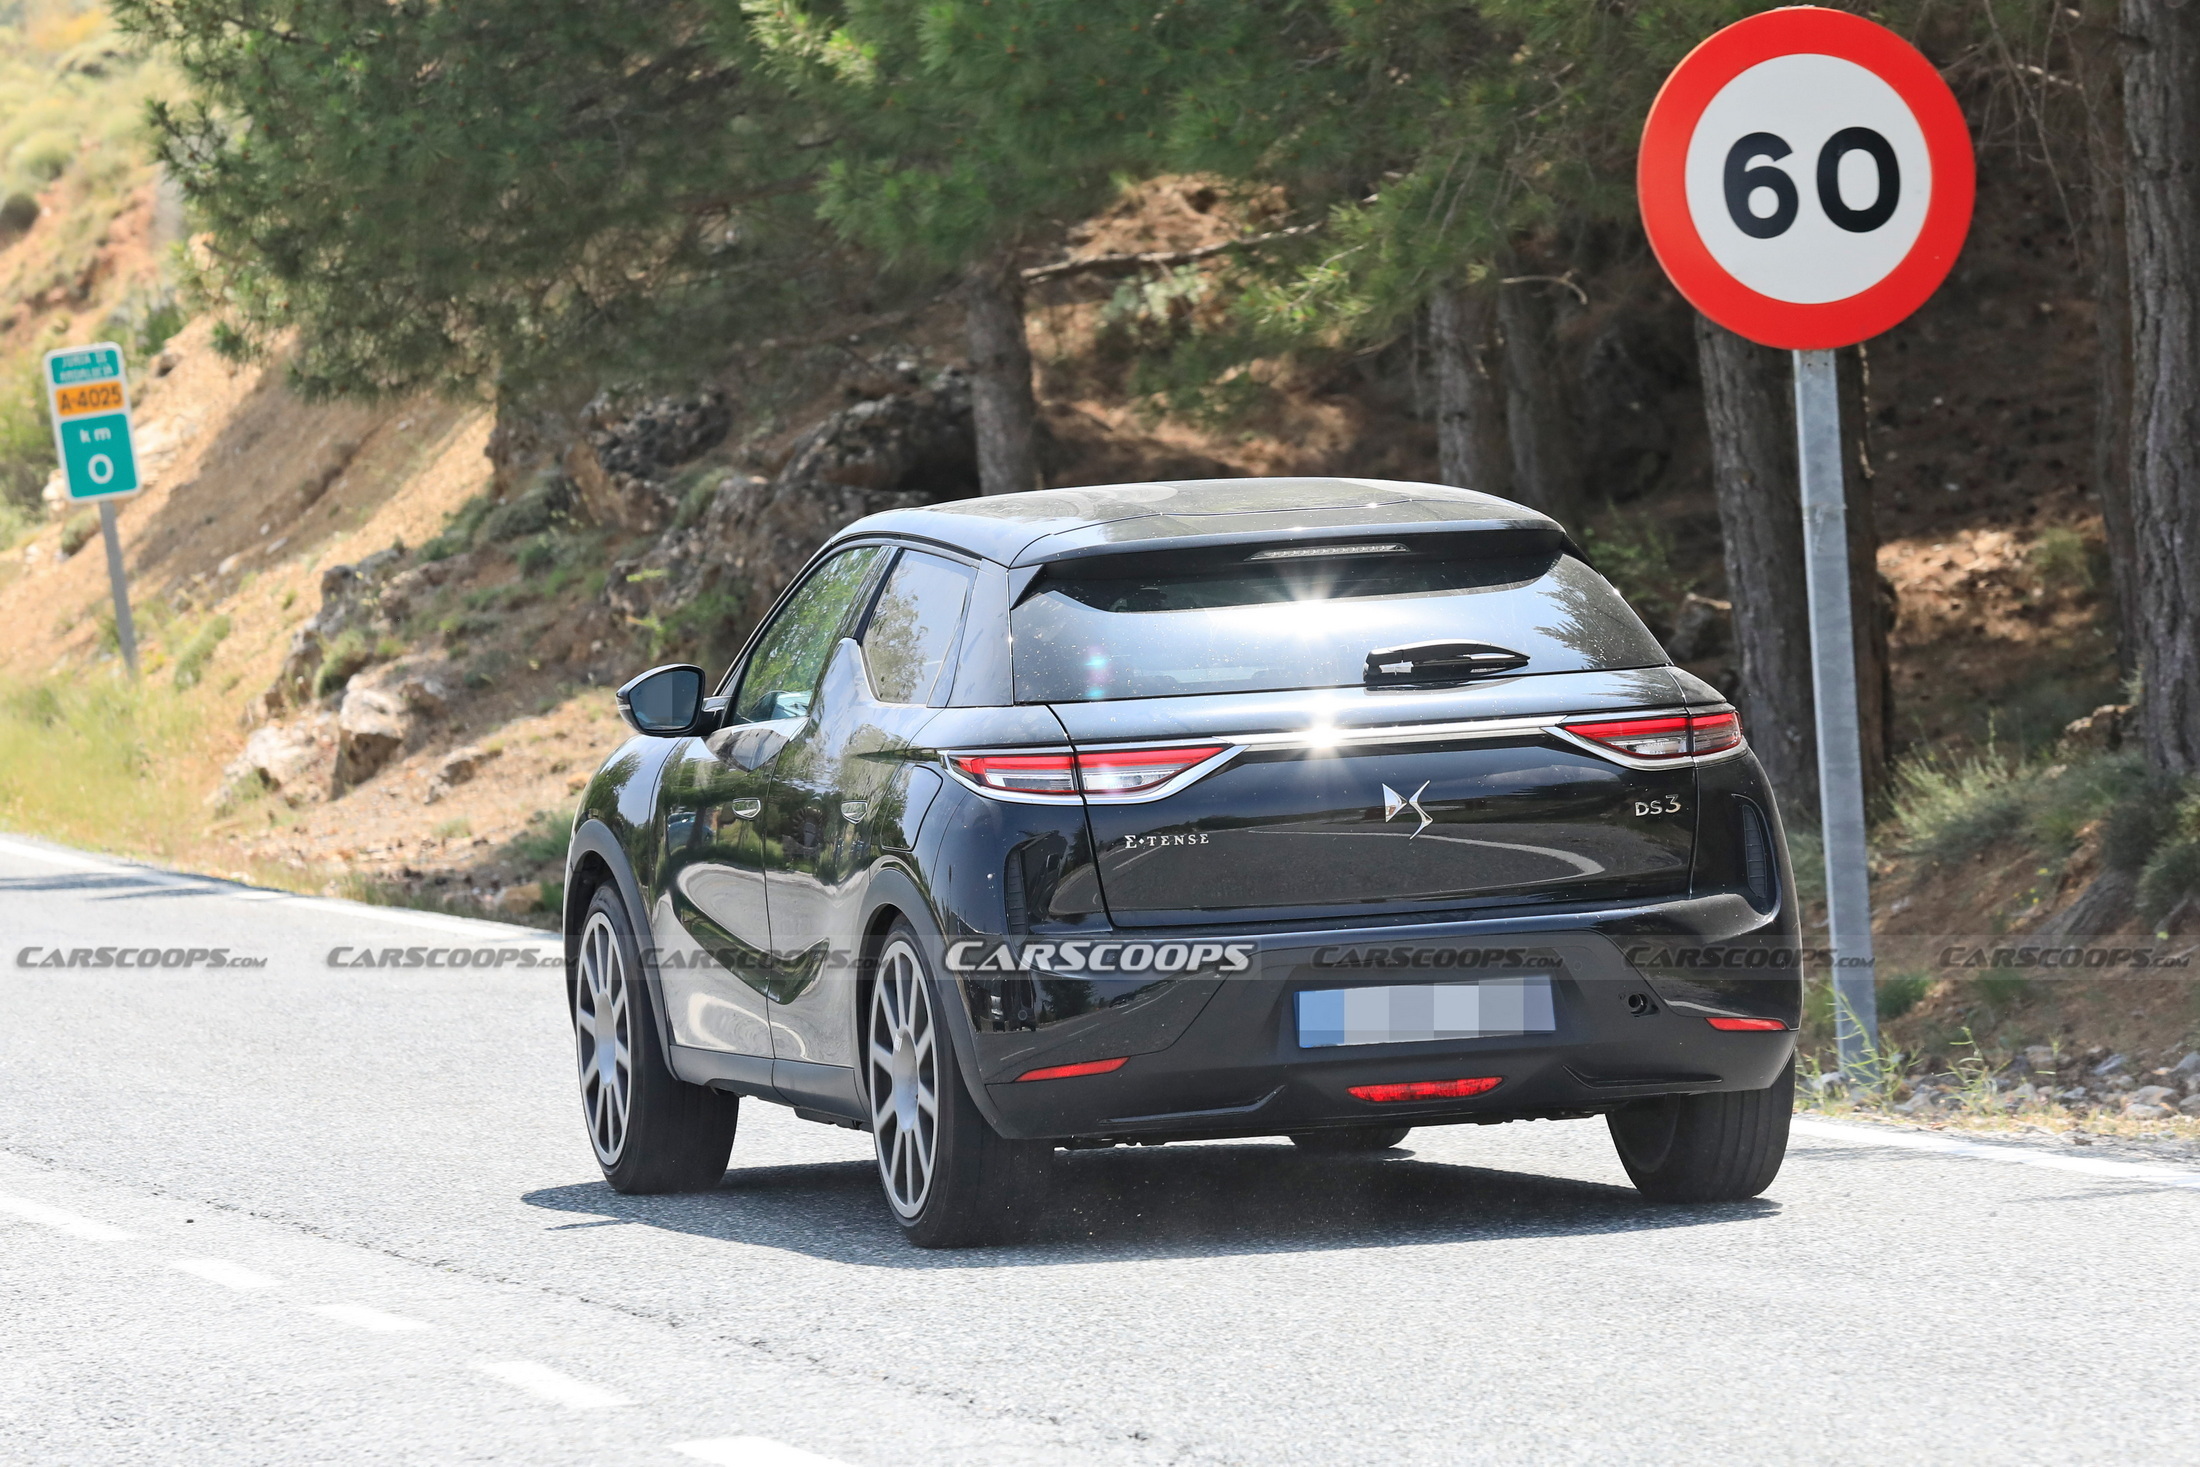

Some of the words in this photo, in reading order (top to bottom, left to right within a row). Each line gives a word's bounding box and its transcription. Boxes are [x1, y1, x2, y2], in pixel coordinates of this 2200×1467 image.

[1723, 126, 1901, 239] 60
[61, 385, 122, 411] A-4025
[79, 426, 112, 444] km
[88, 453, 114, 485] 0
